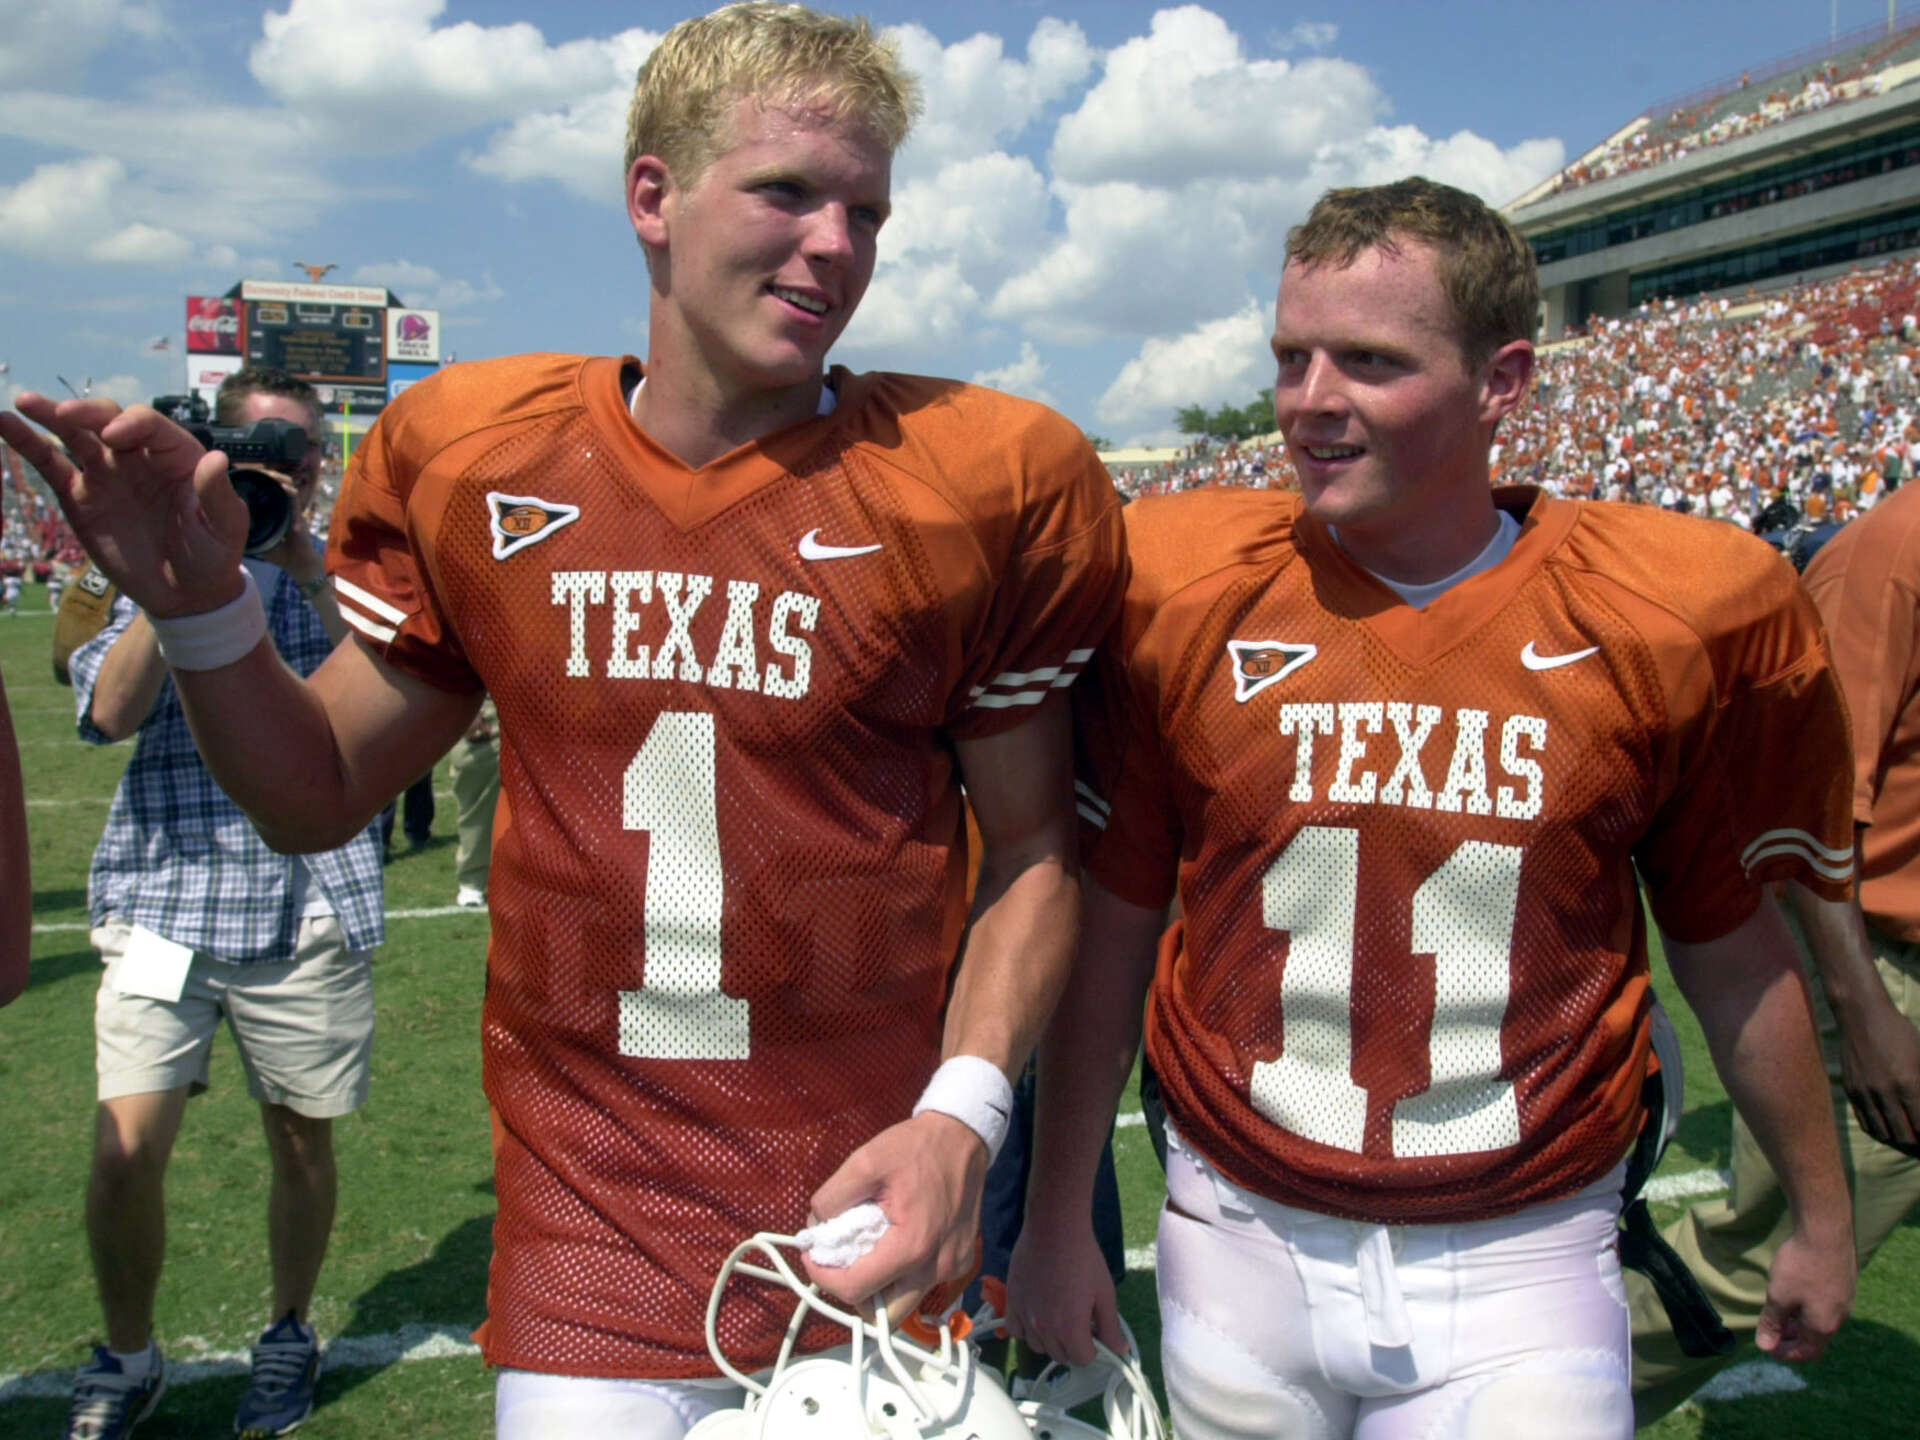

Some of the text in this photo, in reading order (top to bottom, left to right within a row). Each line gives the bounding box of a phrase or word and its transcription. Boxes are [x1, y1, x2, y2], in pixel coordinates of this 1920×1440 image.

[551, 570, 821, 700] TEXAS
[1280, 702, 1547, 820] TEXAS
[618, 711, 750, 1060] 1
[1250, 825, 1524, 1158] 11
